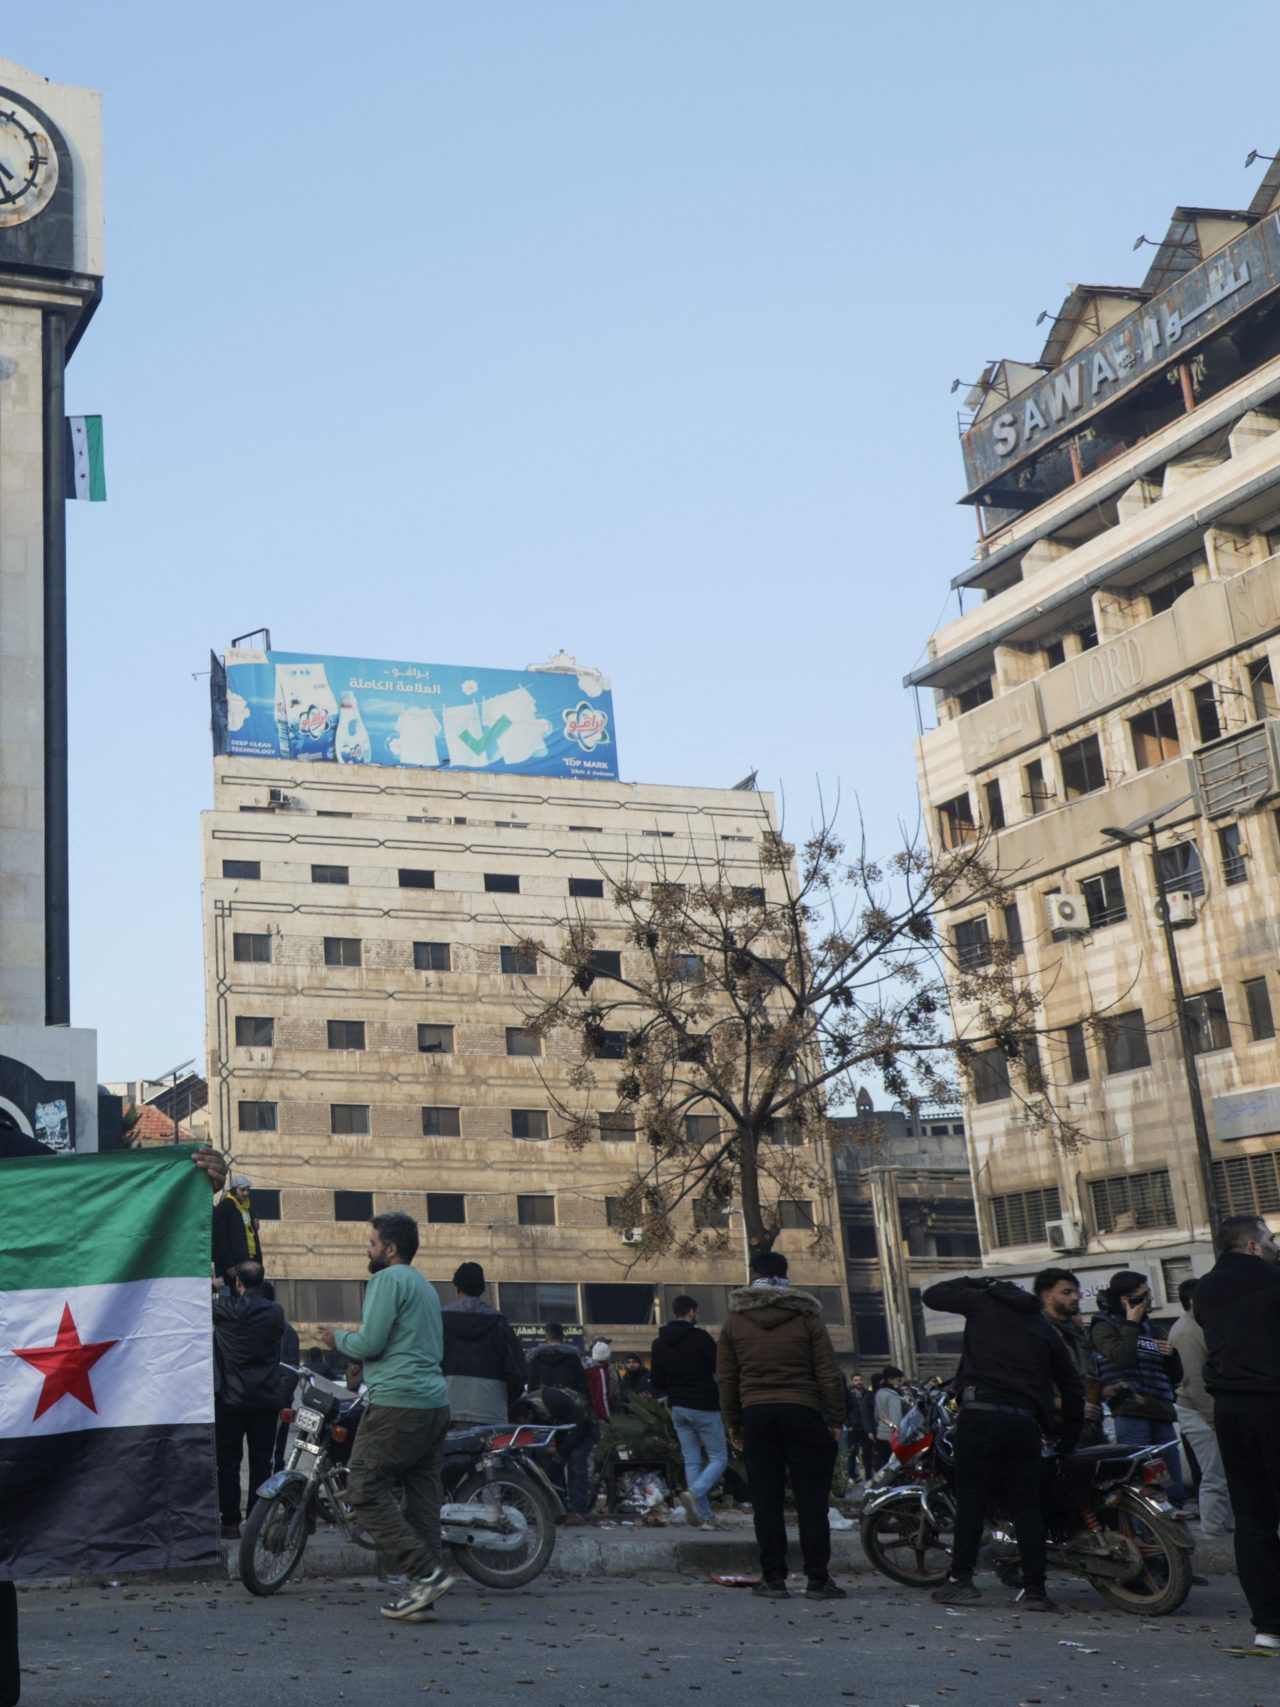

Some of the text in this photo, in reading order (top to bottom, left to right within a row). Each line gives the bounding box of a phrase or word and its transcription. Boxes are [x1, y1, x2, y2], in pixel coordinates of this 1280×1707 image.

[349, 677, 441, 695] العلامة الكاملة
[1070, 637, 1145, 713] LORD
